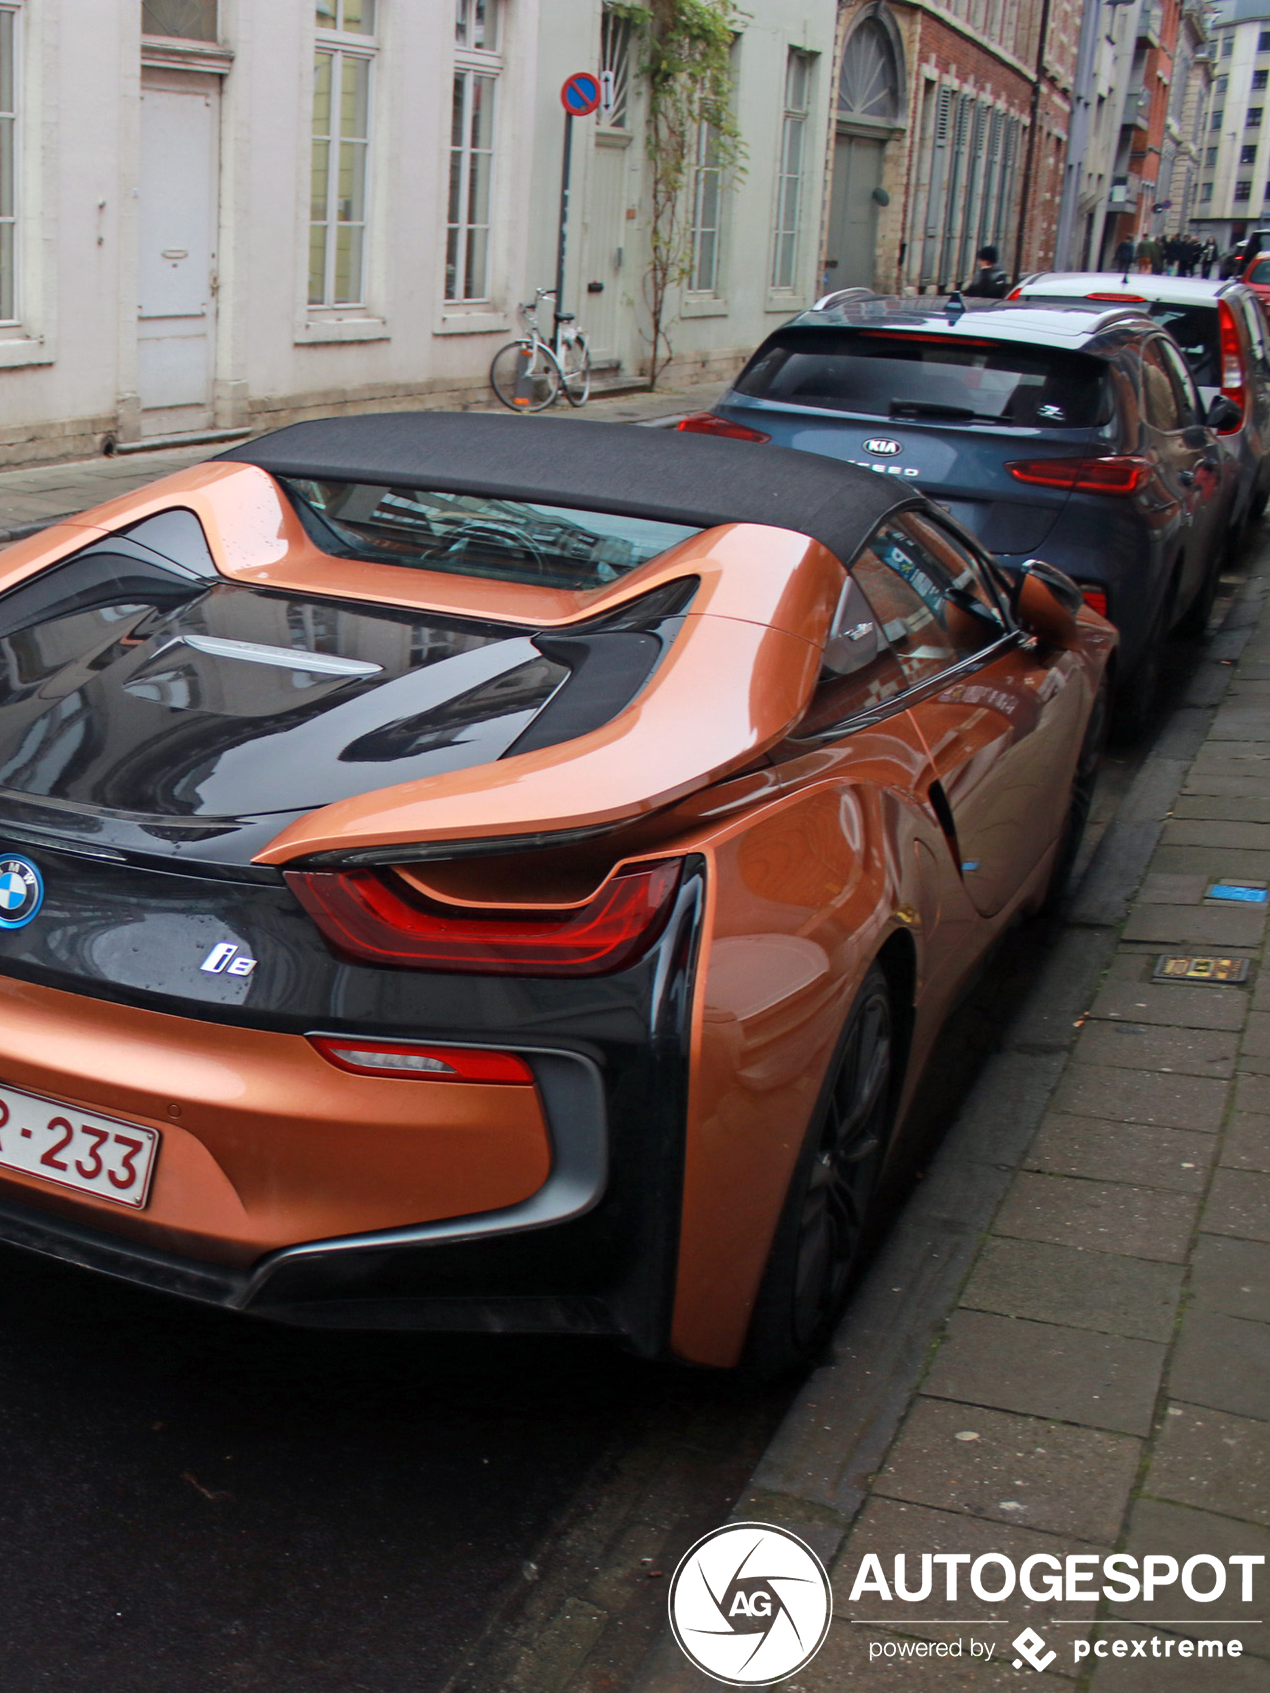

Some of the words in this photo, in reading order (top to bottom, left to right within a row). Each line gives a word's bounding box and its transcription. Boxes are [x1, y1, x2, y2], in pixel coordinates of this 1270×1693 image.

[868, 440, 897, 453] KIA
[847, 460, 919, 477] EED
[199, 943, 258, 976] i8
